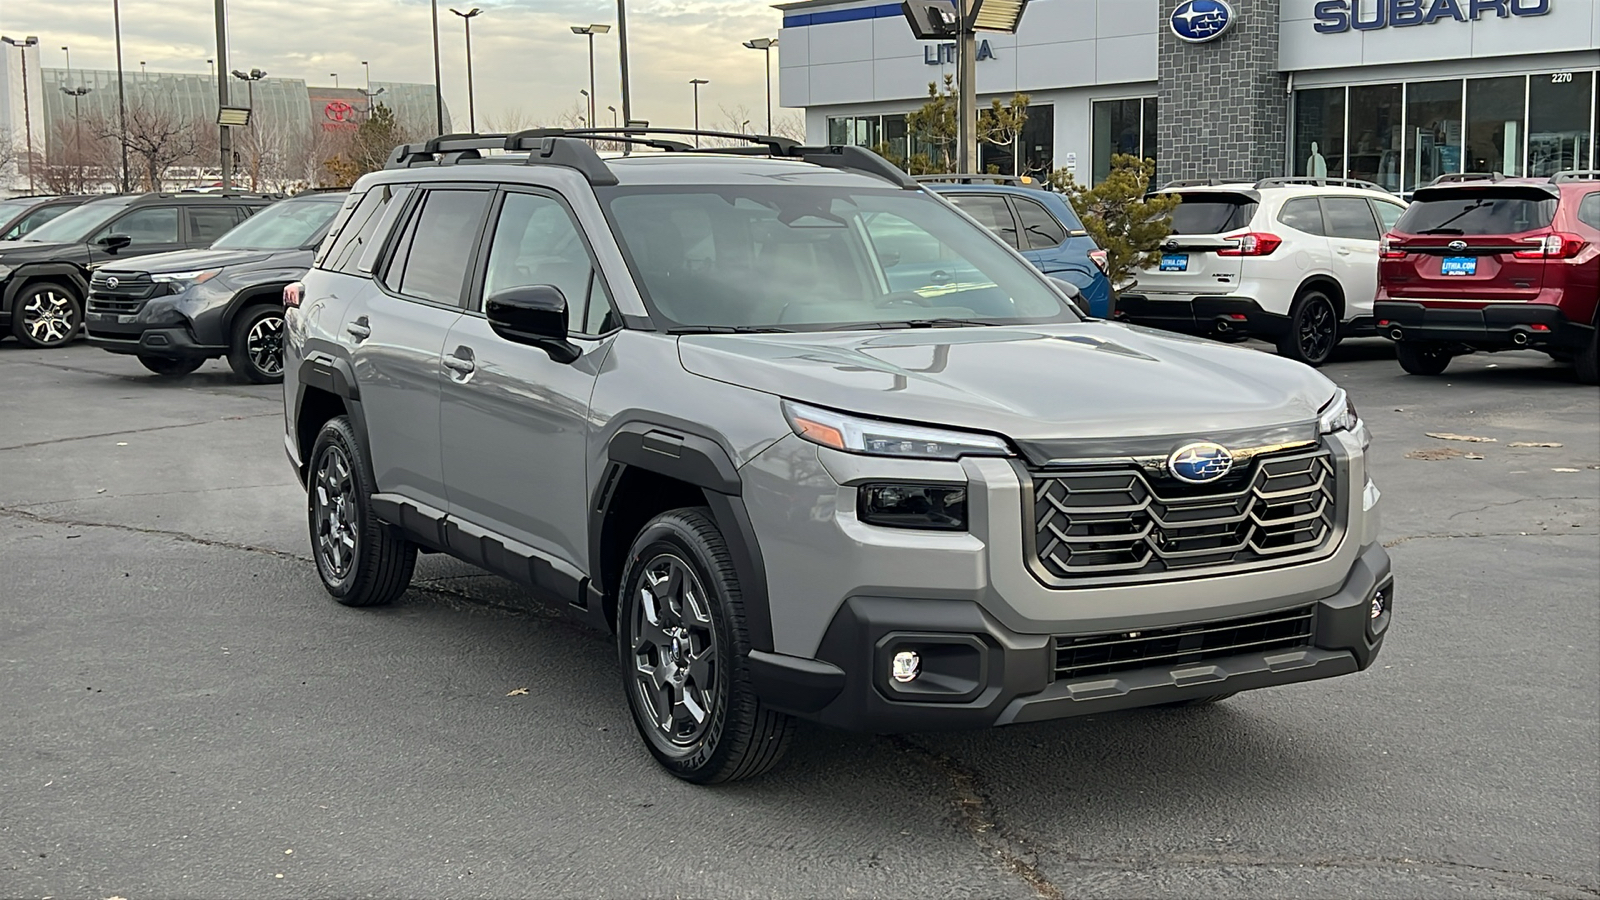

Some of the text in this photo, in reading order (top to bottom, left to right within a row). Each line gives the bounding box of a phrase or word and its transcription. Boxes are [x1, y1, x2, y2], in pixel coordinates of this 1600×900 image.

[924, 39, 996, 65] LITA
[1551, 72, 1573, 84] 2270
[1442, 262, 1476, 270] LITHIA.COM
